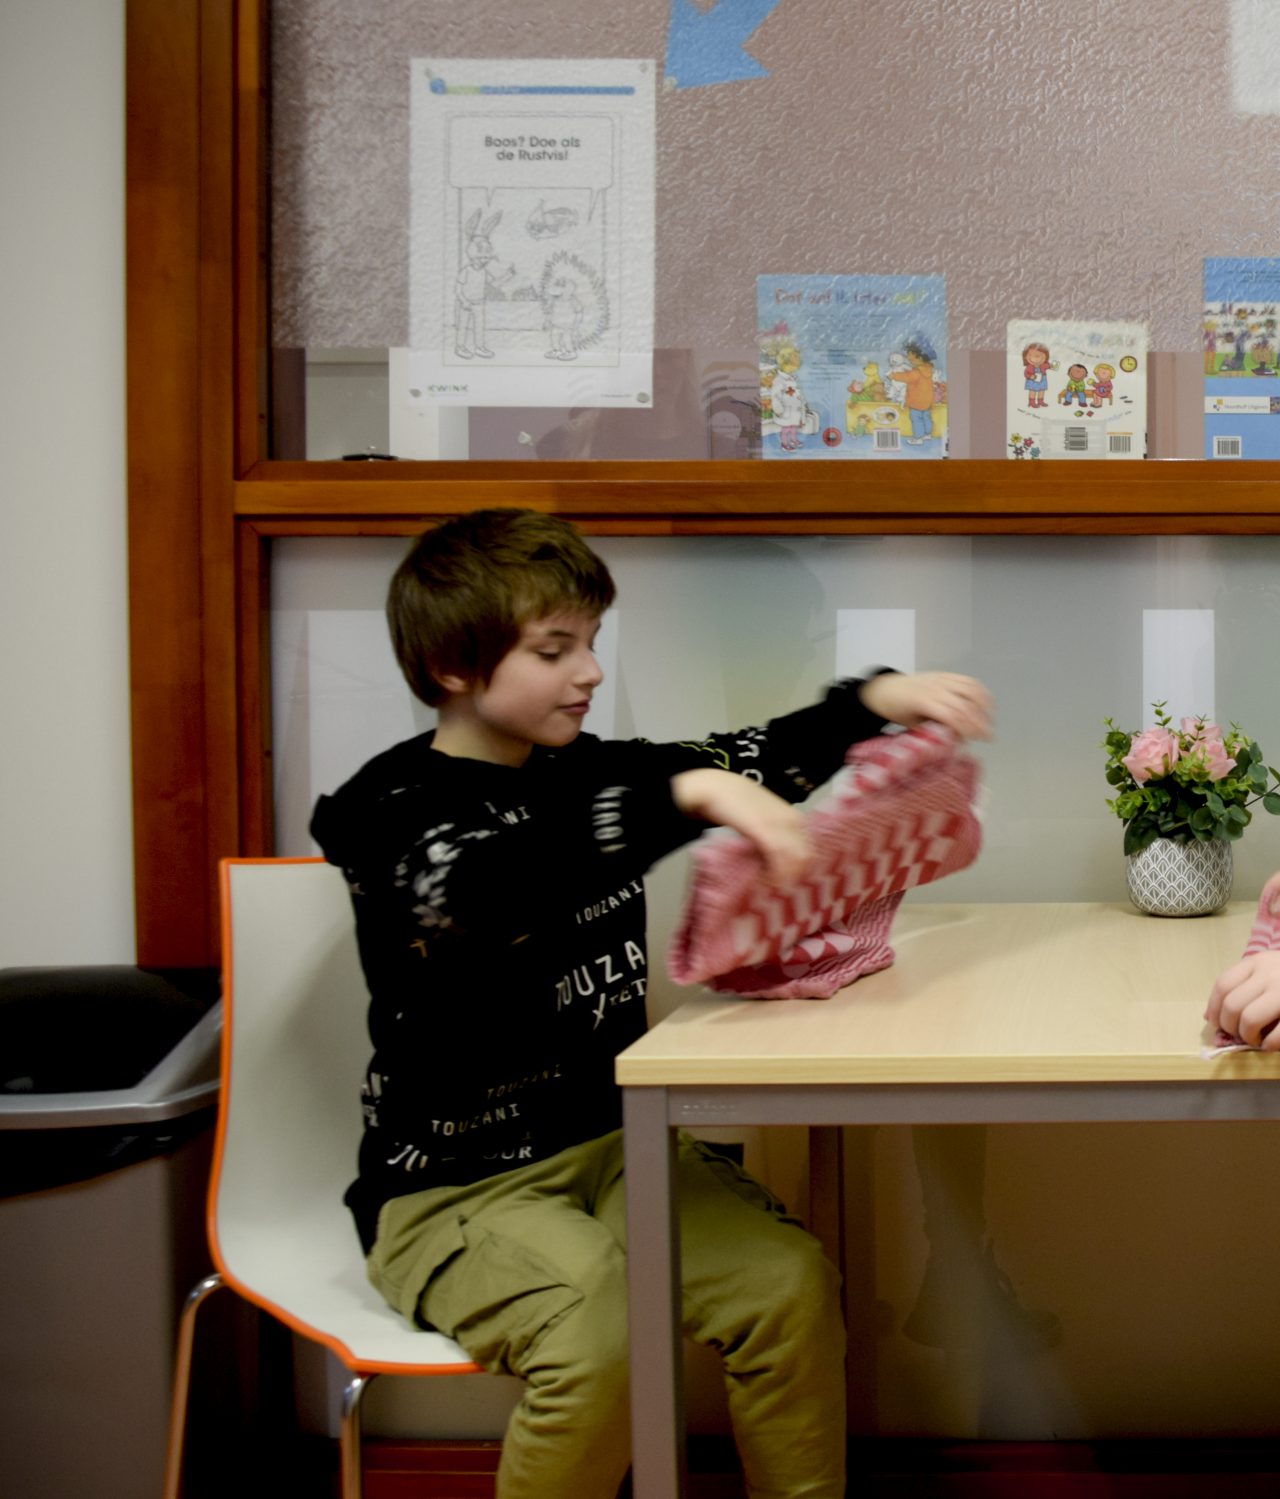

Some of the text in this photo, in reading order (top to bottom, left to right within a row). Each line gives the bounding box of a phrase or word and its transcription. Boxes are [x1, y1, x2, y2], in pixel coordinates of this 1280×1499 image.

[484, 135, 580, 148] Boos? Doe als
[495, 149, 569, 161] de Rustvis!
[431, 1103, 521, 1136] TOUZANI
